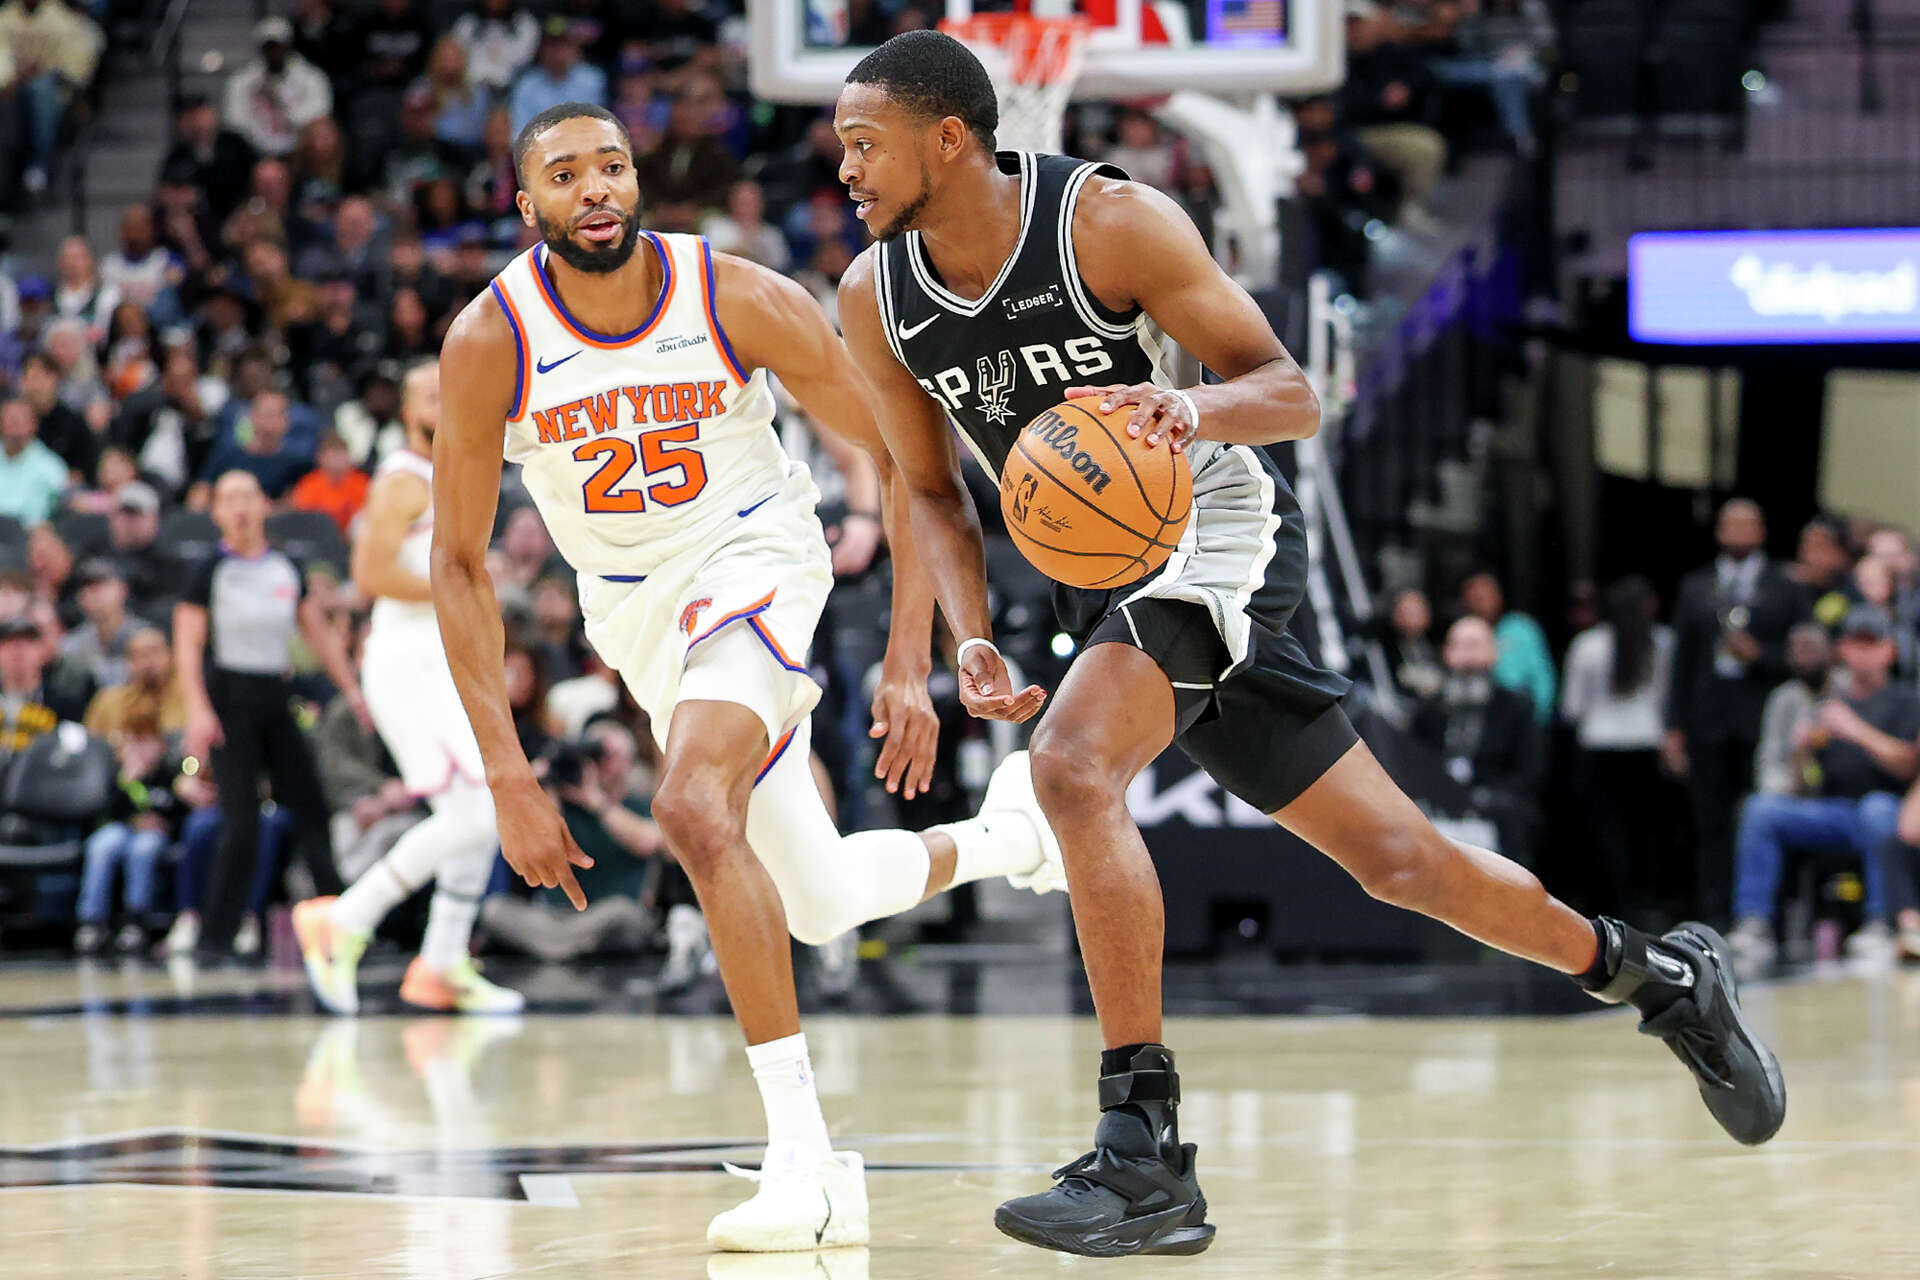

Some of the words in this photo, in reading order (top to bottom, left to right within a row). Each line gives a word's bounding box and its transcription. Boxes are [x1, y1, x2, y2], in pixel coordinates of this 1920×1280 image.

[1011, 293, 1054, 312] LEDGER
[656, 344, 677, 353] abu
[531, 387, 619, 444] NEW
[622, 380, 727, 424] YORK
[572, 421, 708, 514] 25
[1029, 410, 1111, 496] Wilson
